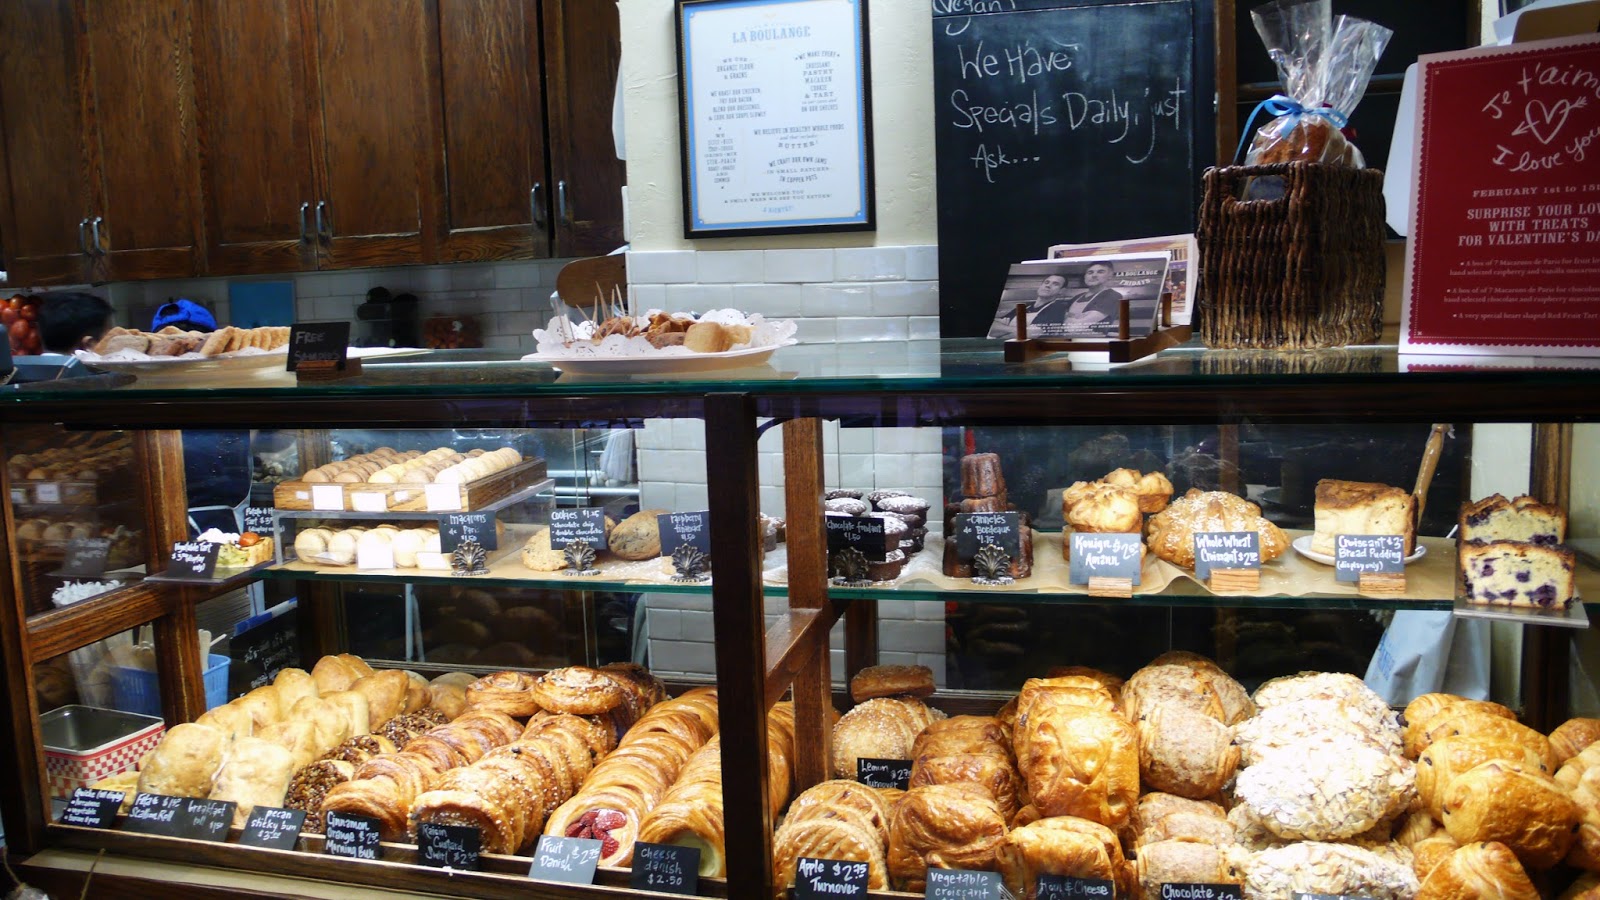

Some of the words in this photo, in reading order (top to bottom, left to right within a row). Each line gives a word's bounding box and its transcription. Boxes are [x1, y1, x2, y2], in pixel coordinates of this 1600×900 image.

[732, 32, 747, 43] LA
[750, 25, 811, 42] BOULANGE
[958, 40, 1000, 79] We
[1004, 42, 1072, 83] Have
[1481, 90, 1512, 119] Je
[951, 89, 1057, 135] Specials
[1126, 77, 1186, 164] just
[1492, 144, 1514, 165] I
[1508, 151, 1563, 171] love
[1565, 126, 1600, 161] you
[1472, 187, 1539, 198] FEBRUARY
[1543, 186, 1560, 194] 1st
[1565, 185, 1577, 193] to
[1467, 206, 1531, 220] SURPRISE
[1537, 203, 1572, 217] YOUR
[1489, 220, 1526, 232] WITH
[1532, 217, 1589, 230] TREATS
[1458, 235, 1482, 246] FOR
[1488, 231, 1580, 246] VALENTINE'S
[856, 520, 882, 533] fondant
[975, 525, 1011, 535] Bordeaux
[1074, 534, 1111, 557] Kouign
[1195, 534, 1223, 549] Whole
[1224, 534, 1252, 549] Wheat
[1338, 535, 1386, 549] Croissant
[1339, 547, 1367, 559] Bread
[1369, 548, 1402, 563] Pudding
[860, 759, 889, 772] Lemon
[187, 800, 227, 817] breakfast
[265, 809, 292, 822] pecan
[251, 818, 278, 834] sticky
[280, 820, 297, 831] bun
[327, 810, 370, 831] Cinnamon
[327, 827, 355, 845] Orange
[422, 823, 448, 839] Raisin
[326, 839, 357, 858] Morning
[540, 837, 564, 853] Fruit
[540, 853, 573, 872] Danish
[644, 860, 682, 875] danish
[798, 858, 825, 878] Apple
[810, 876, 860, 895] Turnover
[935, 886, 990, 899] croissant
[1162, 884, 1214, 899] Chocolate
